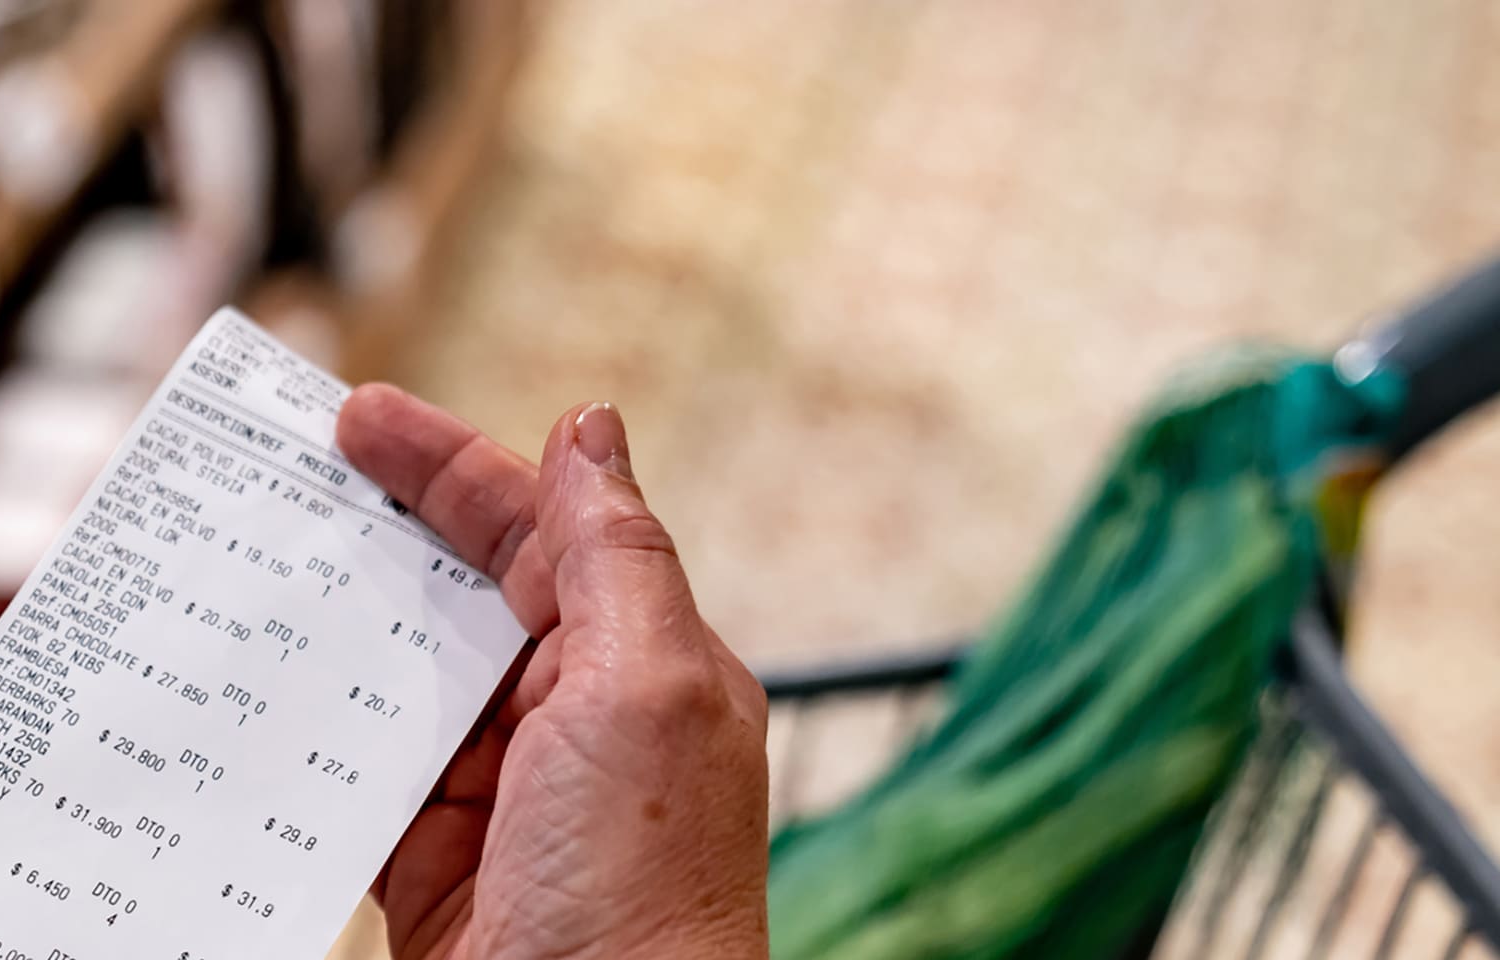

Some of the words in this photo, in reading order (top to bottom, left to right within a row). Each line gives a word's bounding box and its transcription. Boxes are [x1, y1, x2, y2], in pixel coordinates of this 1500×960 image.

[188, 361, 241, 390] ASESOR:
[275, 386, 313, 412] NANCY
[124, 449, 160, 475] 200G
[136, 434, 189, 471] NATURAL
[195, 464, 245, 495] STEVIA
[166, 388, 285, 452] DESCRIPCION/REF
[295, 451, 347, 486] PRECIO
[81, 510, 118, 536] 200G
[93, 495, 148, 531] NATURAL
[154, 525, 181, 545] LOK
[114, 464, 202, 514] Ref:CM05854
[305, 556, 335, 578] DTO
[145, 419, 188, 448] CACAO
[190, 440, 234, 470] POLVO
[237, 464, 263, 484] LOK
[282, 485, 333, 519] 24.800
[447, 567, 483, 590] 49.6
[50, 557, 117, 597] KOKOLATE
[119, 590, 148, 611] CON
[71, 525, 161, 577] Ref:CM00715
[263, 618, 293, 642] DTO
[104, 479, 147, 509] CACAO
[149, 502, 170, 519] EN
[171, 512, 216, 541] POLVO
[244, 546, 293, 578] 19.150
[408, 629, 440, 654] 19.1
[39, 572, 89, 604] PANELA
[92, 597, 129, 623] 250G
[7, 618, 43, 645] EVOK
[45, 637, 67, 656] 82
[68, 649, 105, 674] NIBS
[28, 587, 118, 638] Ref:CM05051
[221, 682, 251, 706] DTO
[61, 541, 104, 570] CACAO
[107, 563, 127, 581] EN
[129, 573, 174, 603] POLVO
[199, 608, 251, 641] 20.750
[363, 692, 401, 718] 20.7
[18, 603, 60, 632] BARRA
[64, 625, 139, 670] CHOCOLATE
[156, 671, 209, 705] 27.850
[321, 758, 358, 784] 27.8
[13, 728, 50, 755] 250G
[178, 748, 208, 772] DTO
[60, 707, 80, 726] 70
[113, 736, 166, 772] 29.800
[279, 824, 317, 851] 29.8
[24, 777, 44, 797] 70
[70, 803, 122, 838] 31.900
[236, 890, 274, 918] 31.9
[135, 815, 165, 839] DTO
[25, 869, 70, 900] 6.450
[91, 881, 121, 905] DTO
